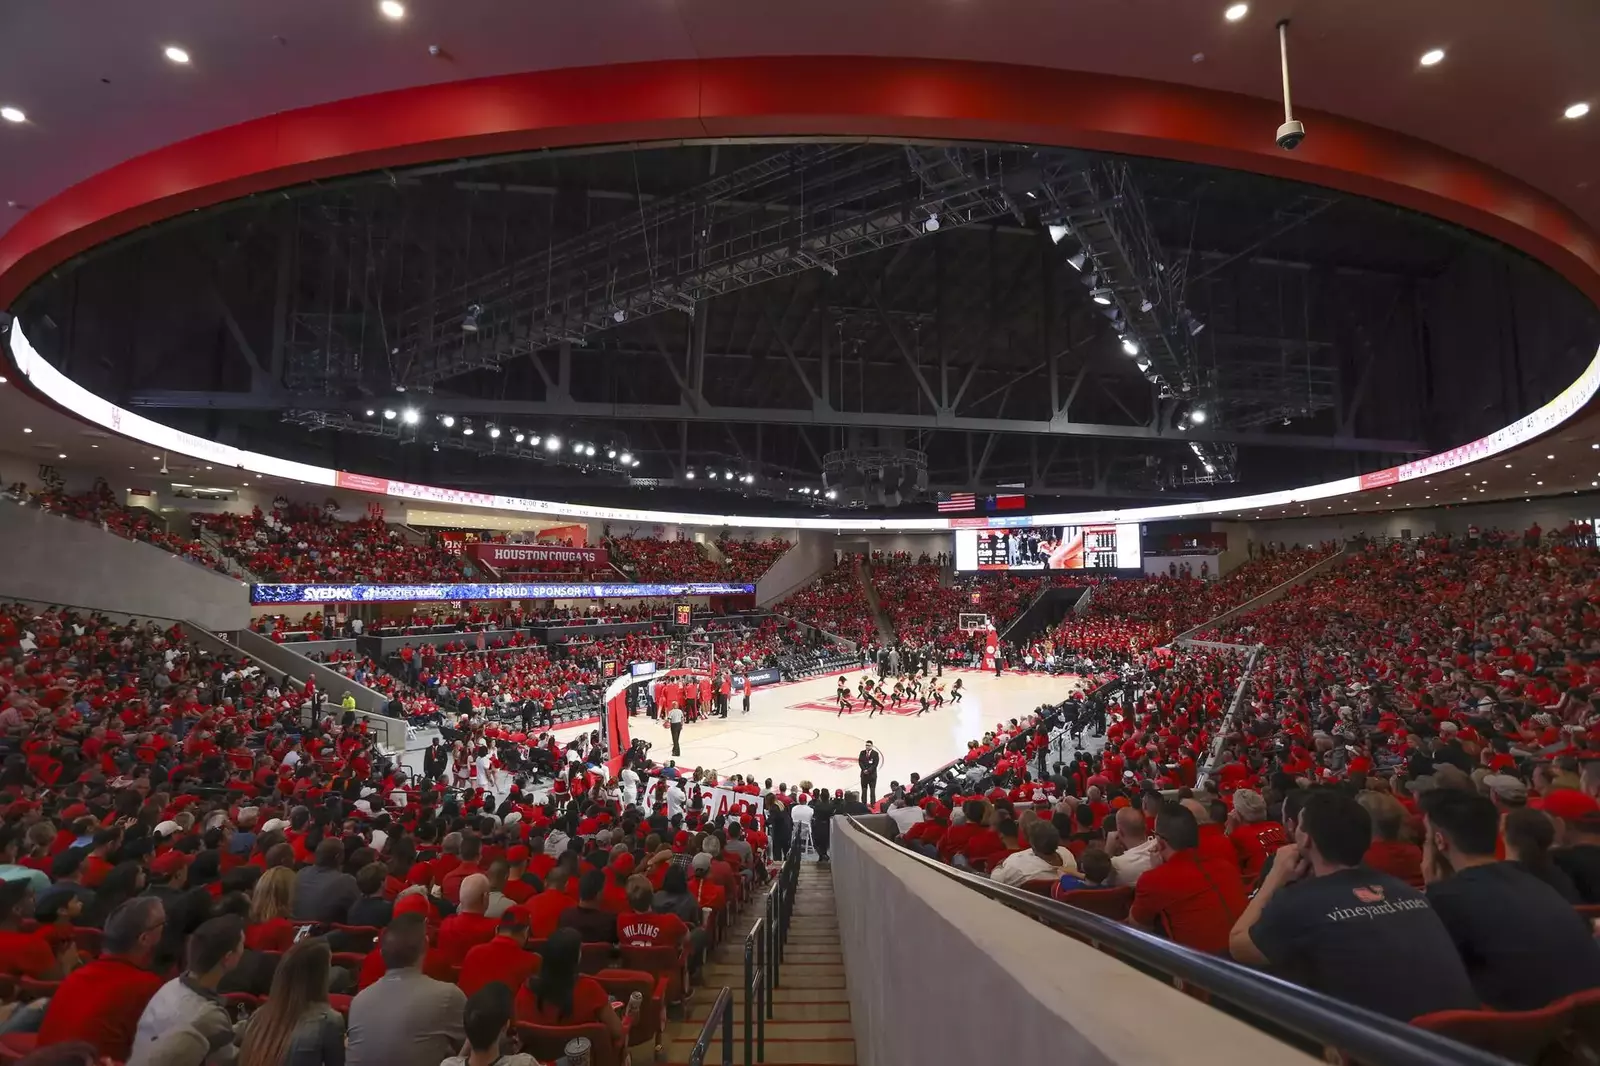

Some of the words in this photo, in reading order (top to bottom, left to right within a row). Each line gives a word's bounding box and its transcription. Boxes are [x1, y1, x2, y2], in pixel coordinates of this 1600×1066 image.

[494, 549, 549, 561] HOUSTON
[549, 551, 596, 562] COUGARS
[303, 586, 353, 600] SVEDKA
[489, 587, 528, 597] PROUD
[533, 587, 581, 596] SPONSOR
[677, 613, 689, 624] 30
[1326, 900, 1396, 921] vineyard
[622, 923, 660, 938] WILKINS
